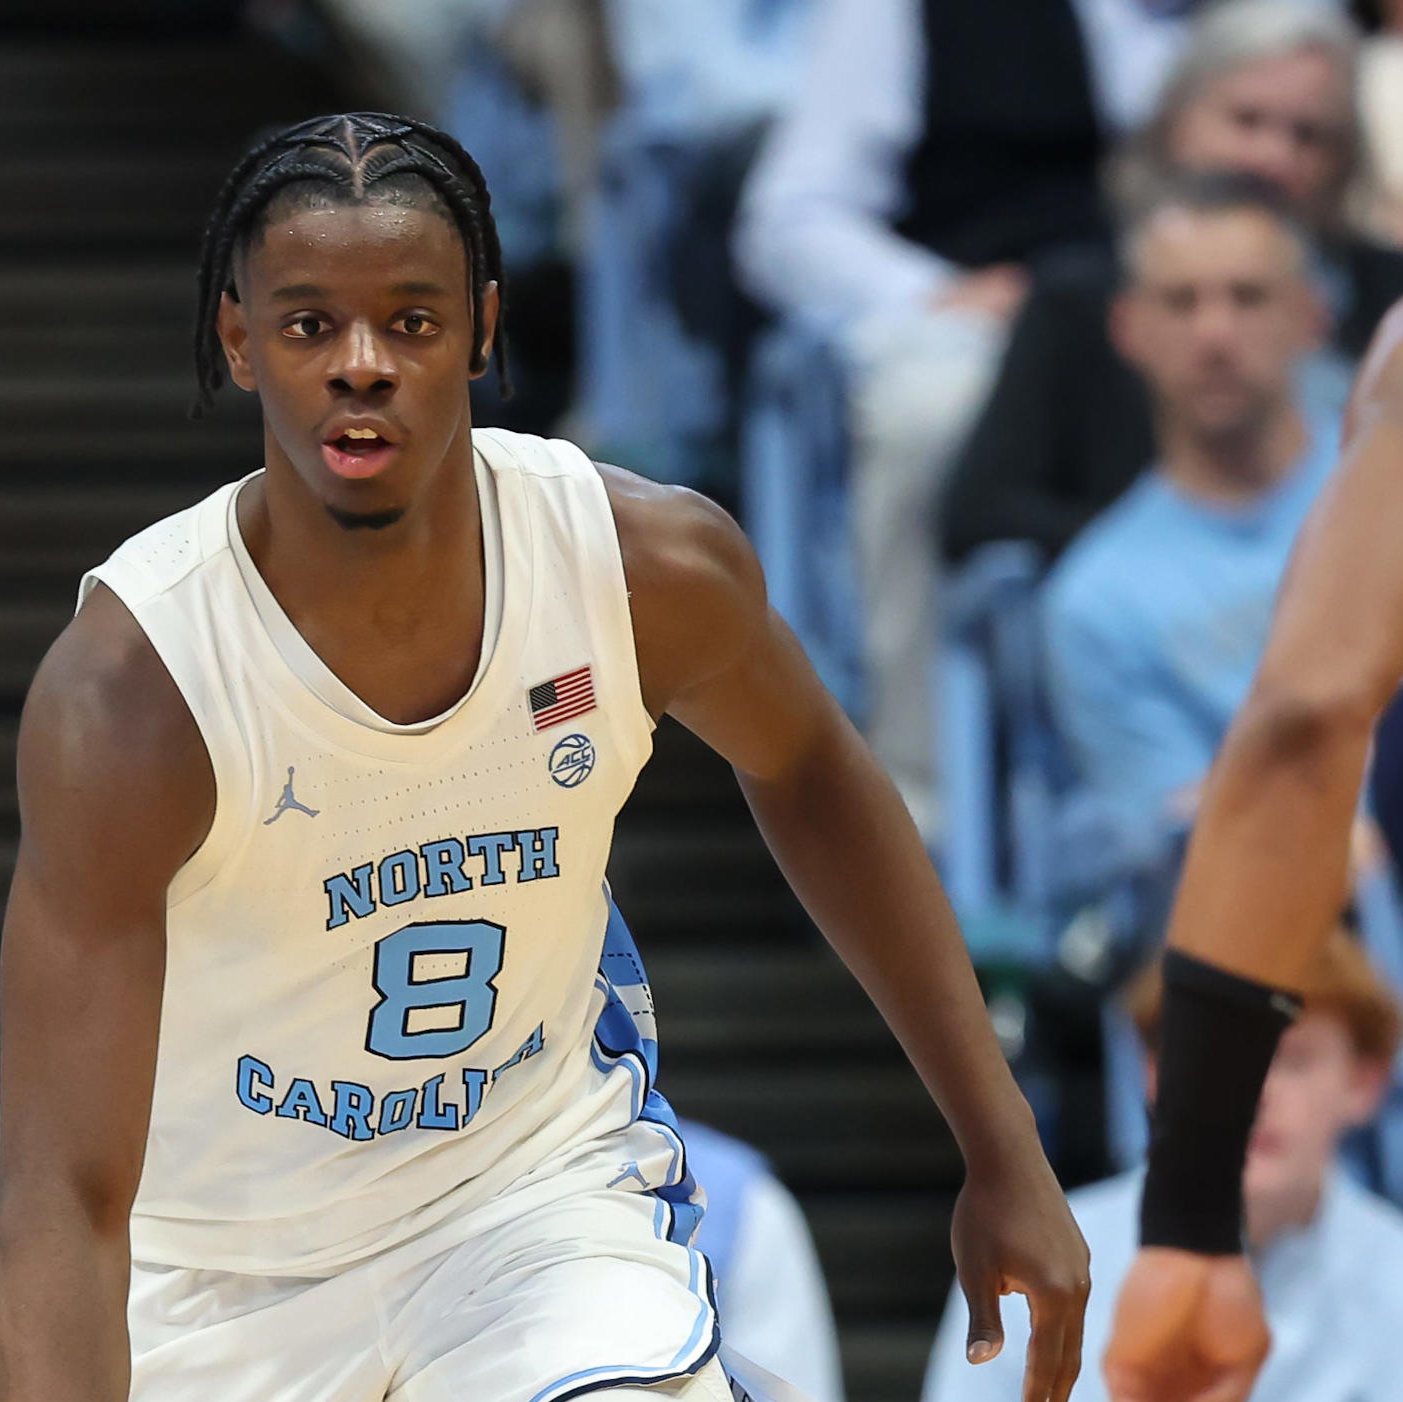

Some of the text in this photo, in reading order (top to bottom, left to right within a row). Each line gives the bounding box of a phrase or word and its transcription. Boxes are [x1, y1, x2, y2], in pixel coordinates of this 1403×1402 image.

[556, 744, 591, 769] ACC
[324, 827, 560, 931] NORTH
[364, 917, 507, 1061] 8
[236, 1020, 545, 1141] CAROLIA
